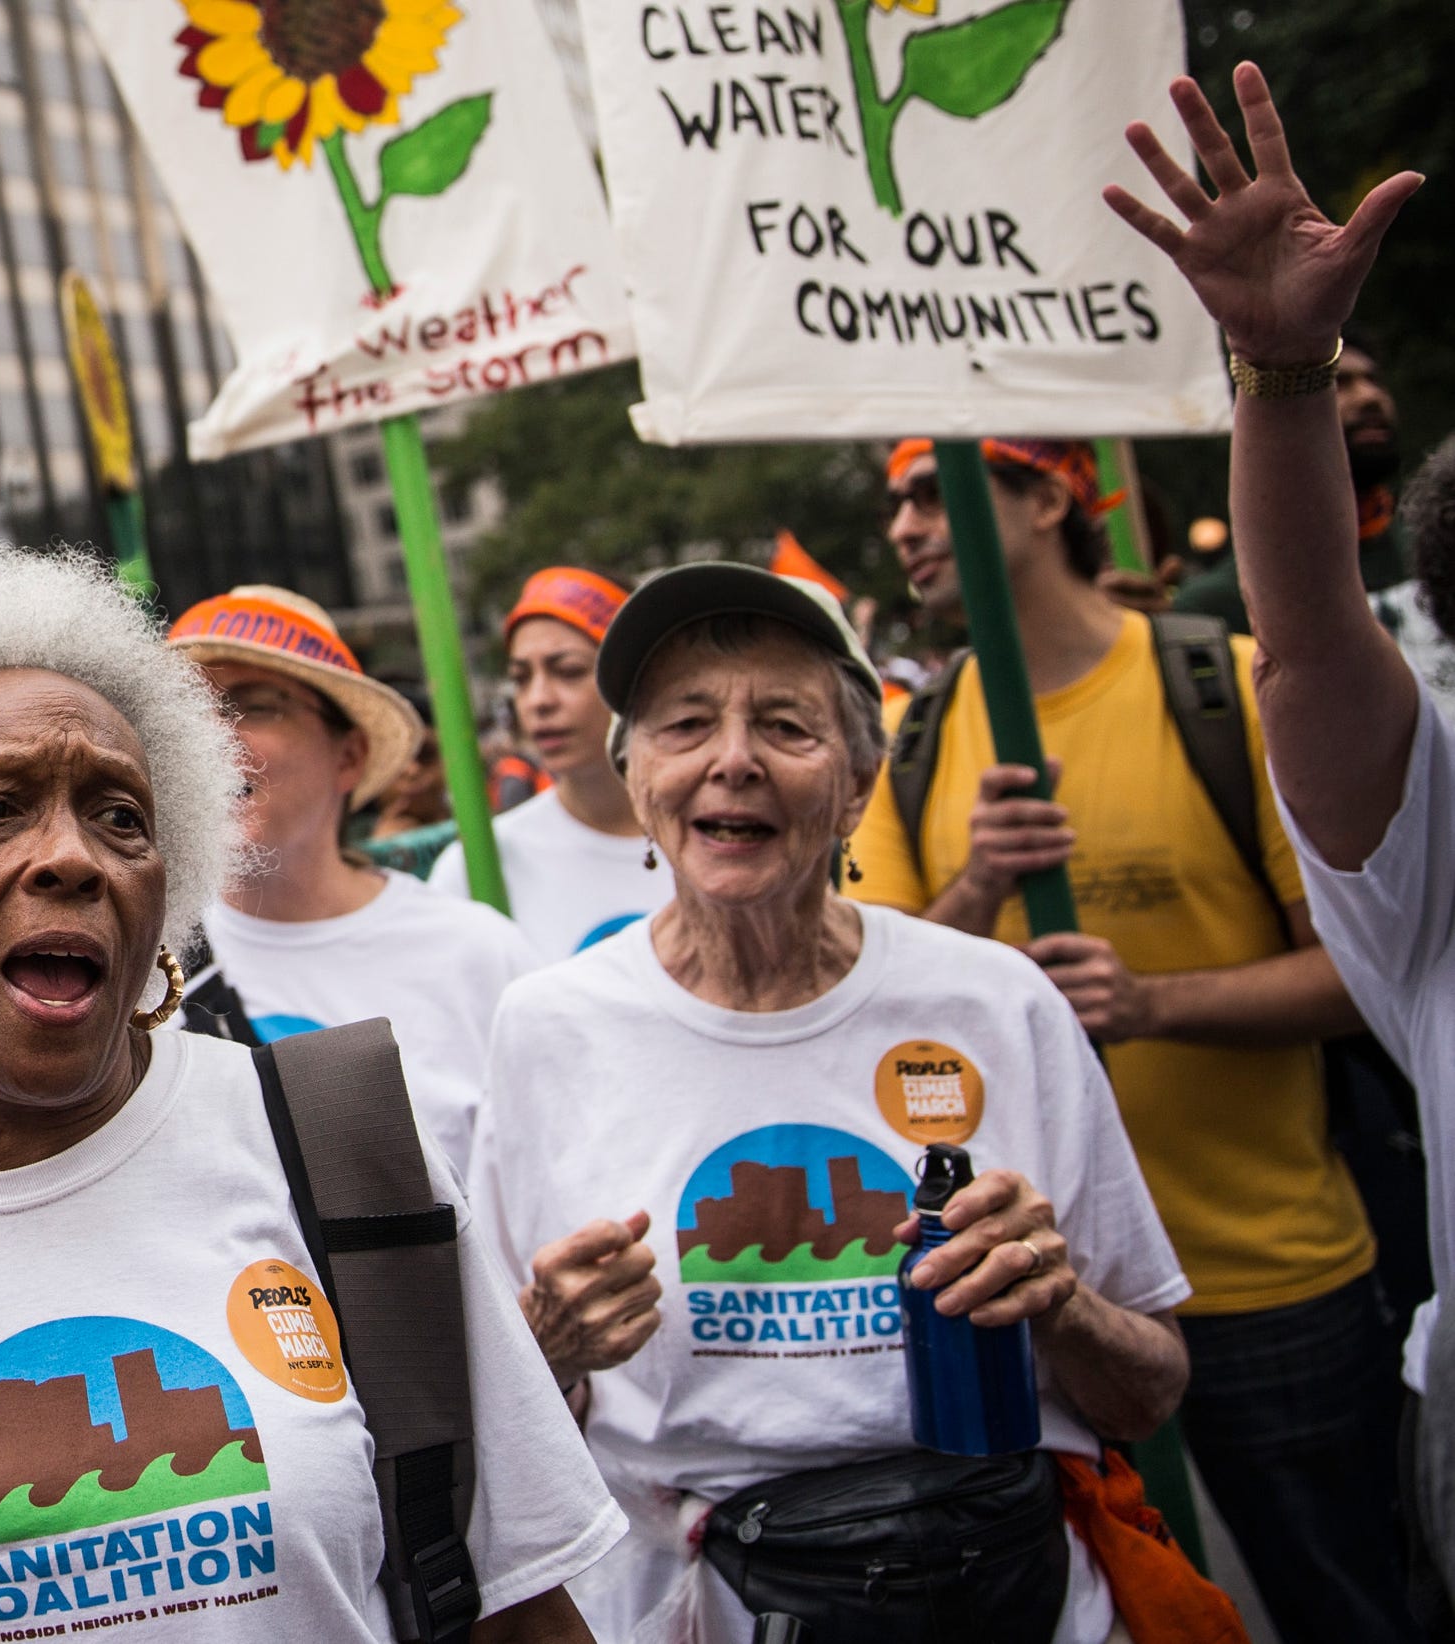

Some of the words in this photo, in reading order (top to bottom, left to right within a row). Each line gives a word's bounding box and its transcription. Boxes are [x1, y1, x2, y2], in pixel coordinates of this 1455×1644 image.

[642, 5, 823, 60] CLEAN
[658, 74, 854, 157] WATER
[747, 201, 868, 264] FOR
[906, 208, 1038, 277] OUR
[356, 265, 588, 360] Weather
[797, 280, 1161, 343] COMMUNITIES
[248, 1286, 312, 1310] PEOPLE'S
[688, 1283, 902, 1315] SANITATIO
[267, 1311, 321, 1335] CLIMATE
[276, 1334, 331, 1359] MARCH
[691, 1311, 903, 1342] COALITIO
[71, 1609, 147, 1632] HEIGHTS
[163, 1599, 209, 1616] WEST
[214, 1585, 279, 1607] HARLEM
